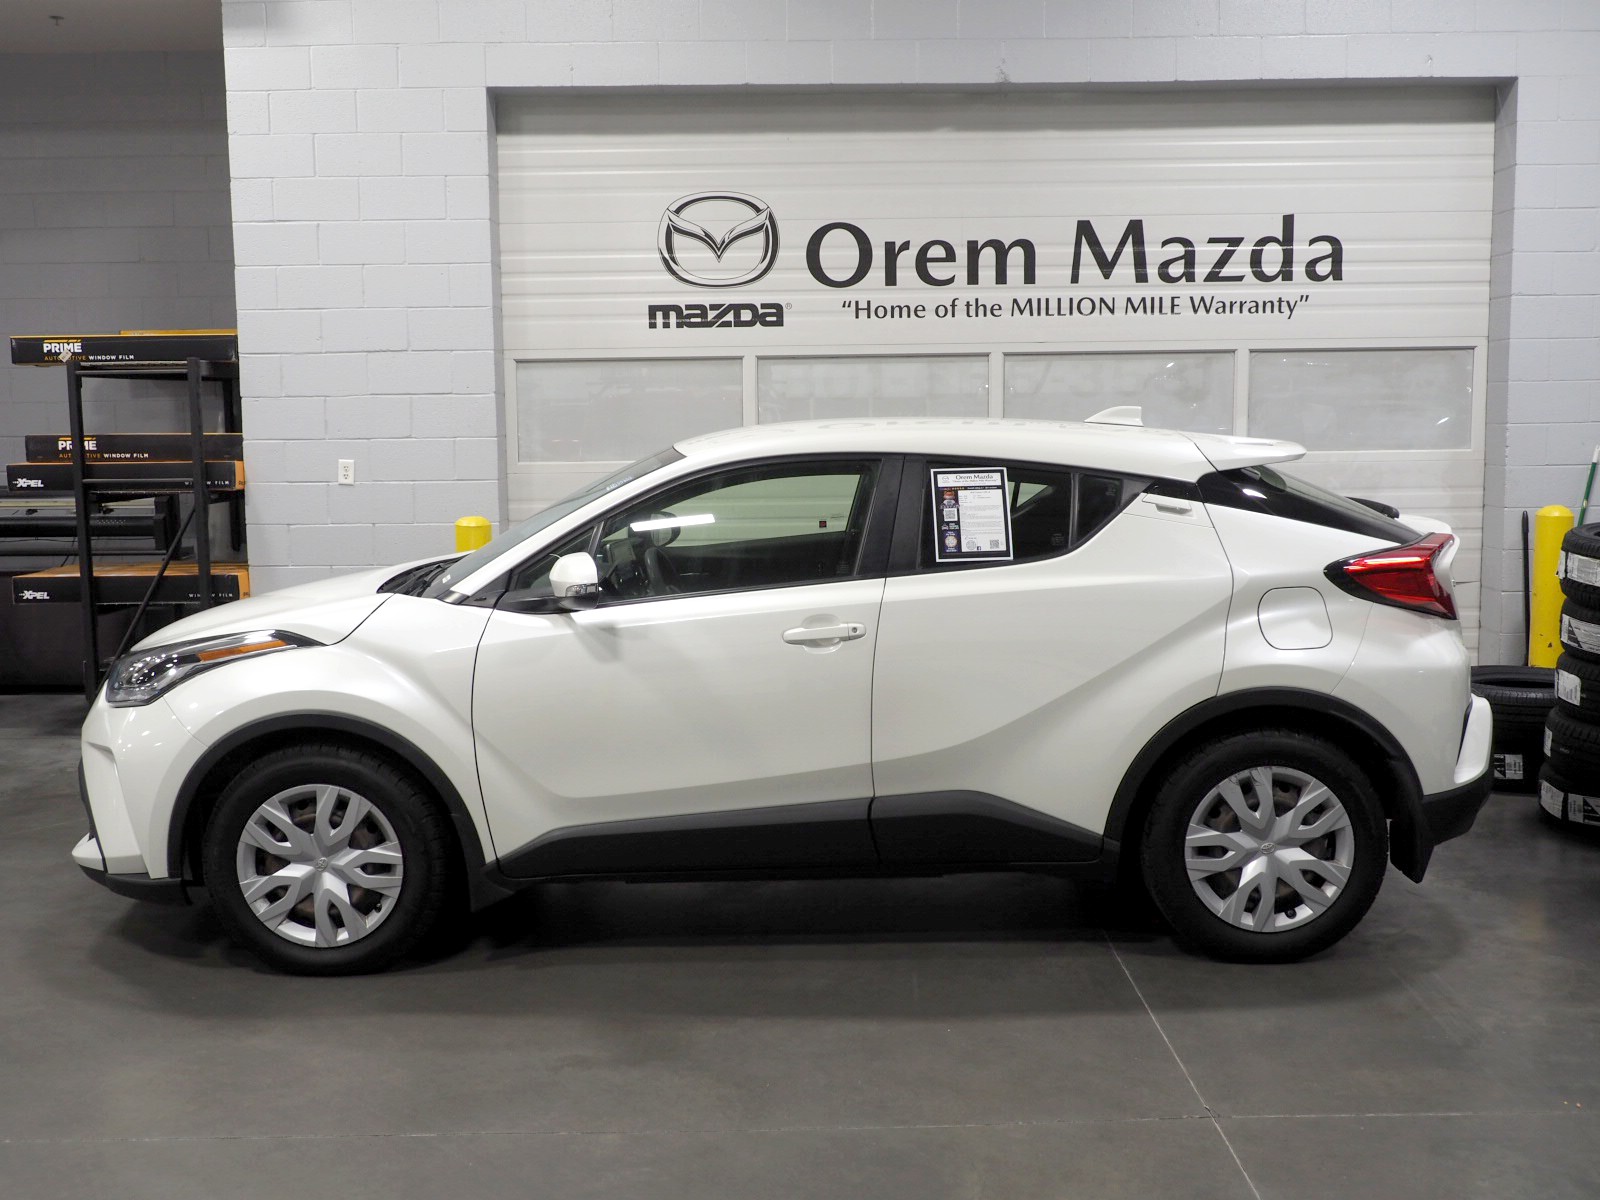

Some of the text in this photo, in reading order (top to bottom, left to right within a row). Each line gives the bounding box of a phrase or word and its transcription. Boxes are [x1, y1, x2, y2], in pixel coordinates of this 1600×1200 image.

[805, 214, 1344, 289] Orem Mazda
[934, 298, 959, 318] of
[965, 298, 1002, 318] the
[1011, 295, 1116, 318] MILLION
[1124, 296, 1182, 316] MILE
[43, 342, 82, 353] PRIME
[58, 440, 97, 451] PRE
[14, 478, 44, 488] XPEL
[20, 590, 50, 600] XPEL
